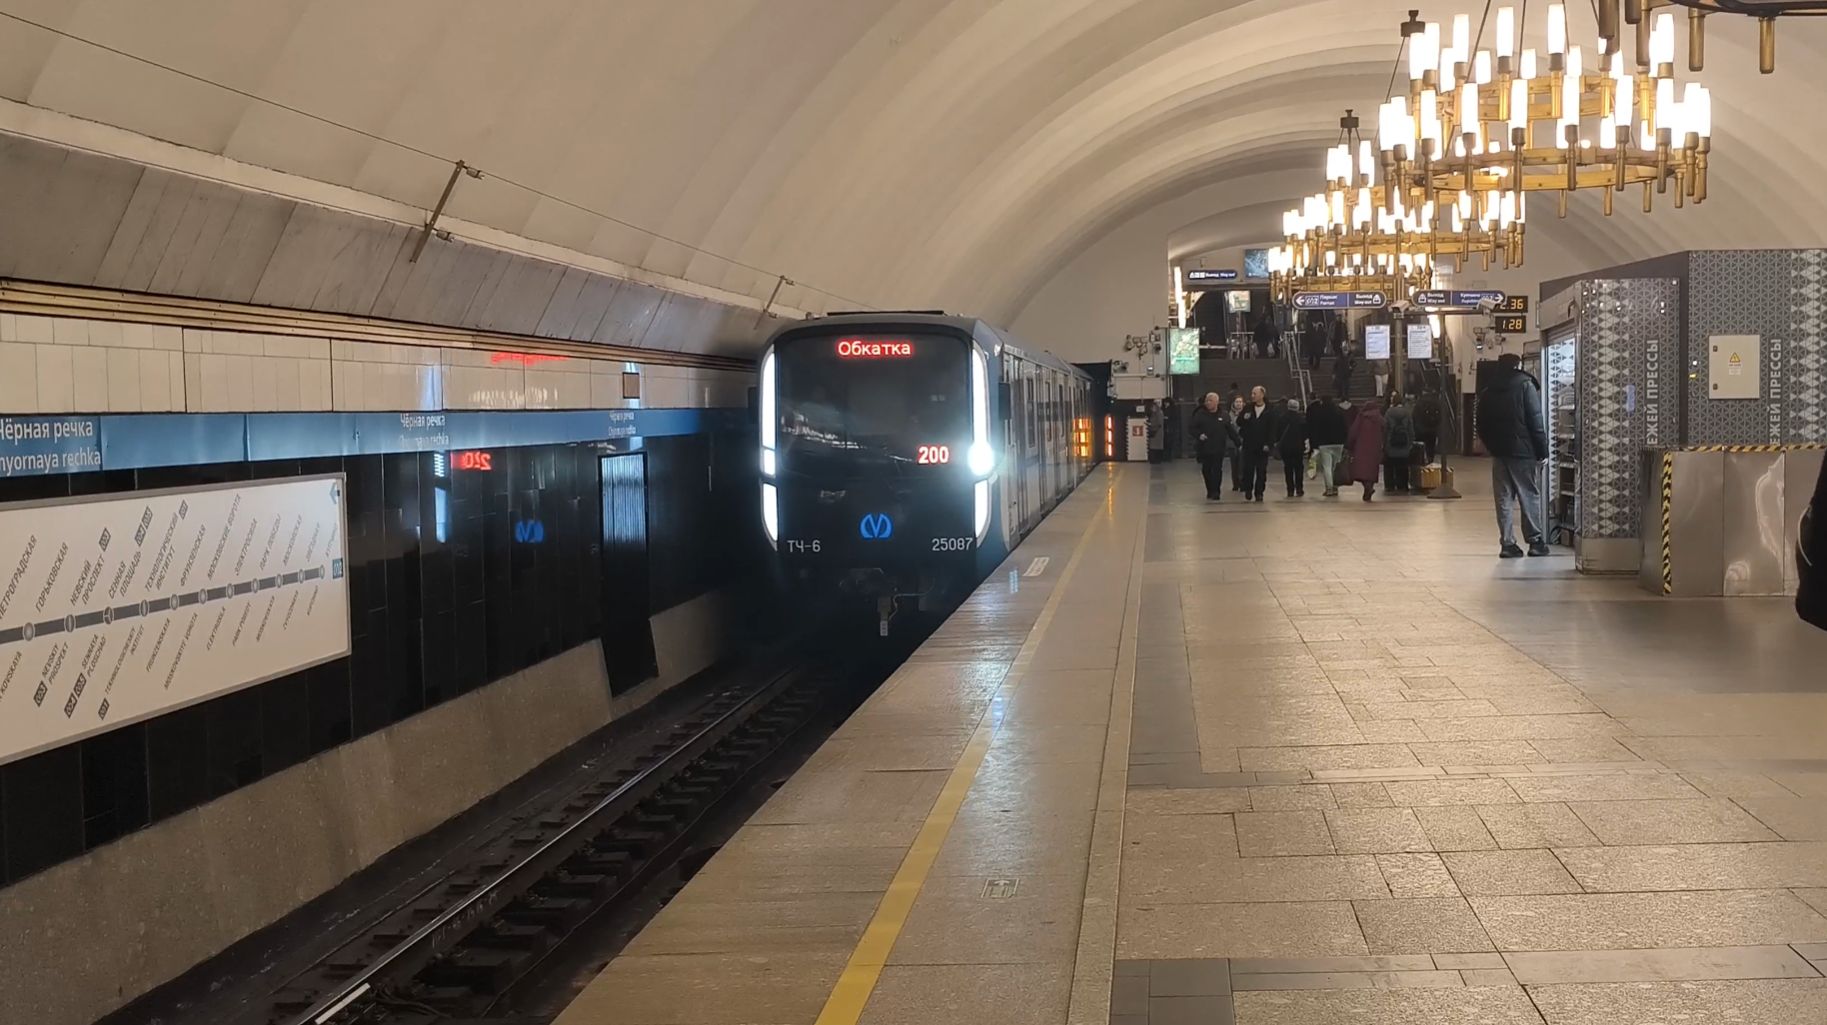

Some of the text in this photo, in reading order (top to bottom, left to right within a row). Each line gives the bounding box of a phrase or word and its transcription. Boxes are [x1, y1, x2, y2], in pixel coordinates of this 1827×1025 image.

[837, 340, 912, 357] Обкатка
[1646, 339, 1659, 399] ПРЕССЫ
[1770, 338, 1781, 399] ПРЕССЫ
[54, 420, 94, 444] речка
[62, 446, 101, 468] rechka
[917, 446, 950, 464] 200
[931, 537, 974, 552] 25087
[35, 541, 69, 613] ГОРЬКОВСКАЯ
[70, 559, 92, 607] НЕВСКИЙ
[81, 554, 105, 606] ПРОСПЕКТ
[108, 560, 127, 600] СЕННАЯ
[119, 551, 142, 597] ПЛОЩАДЬ
